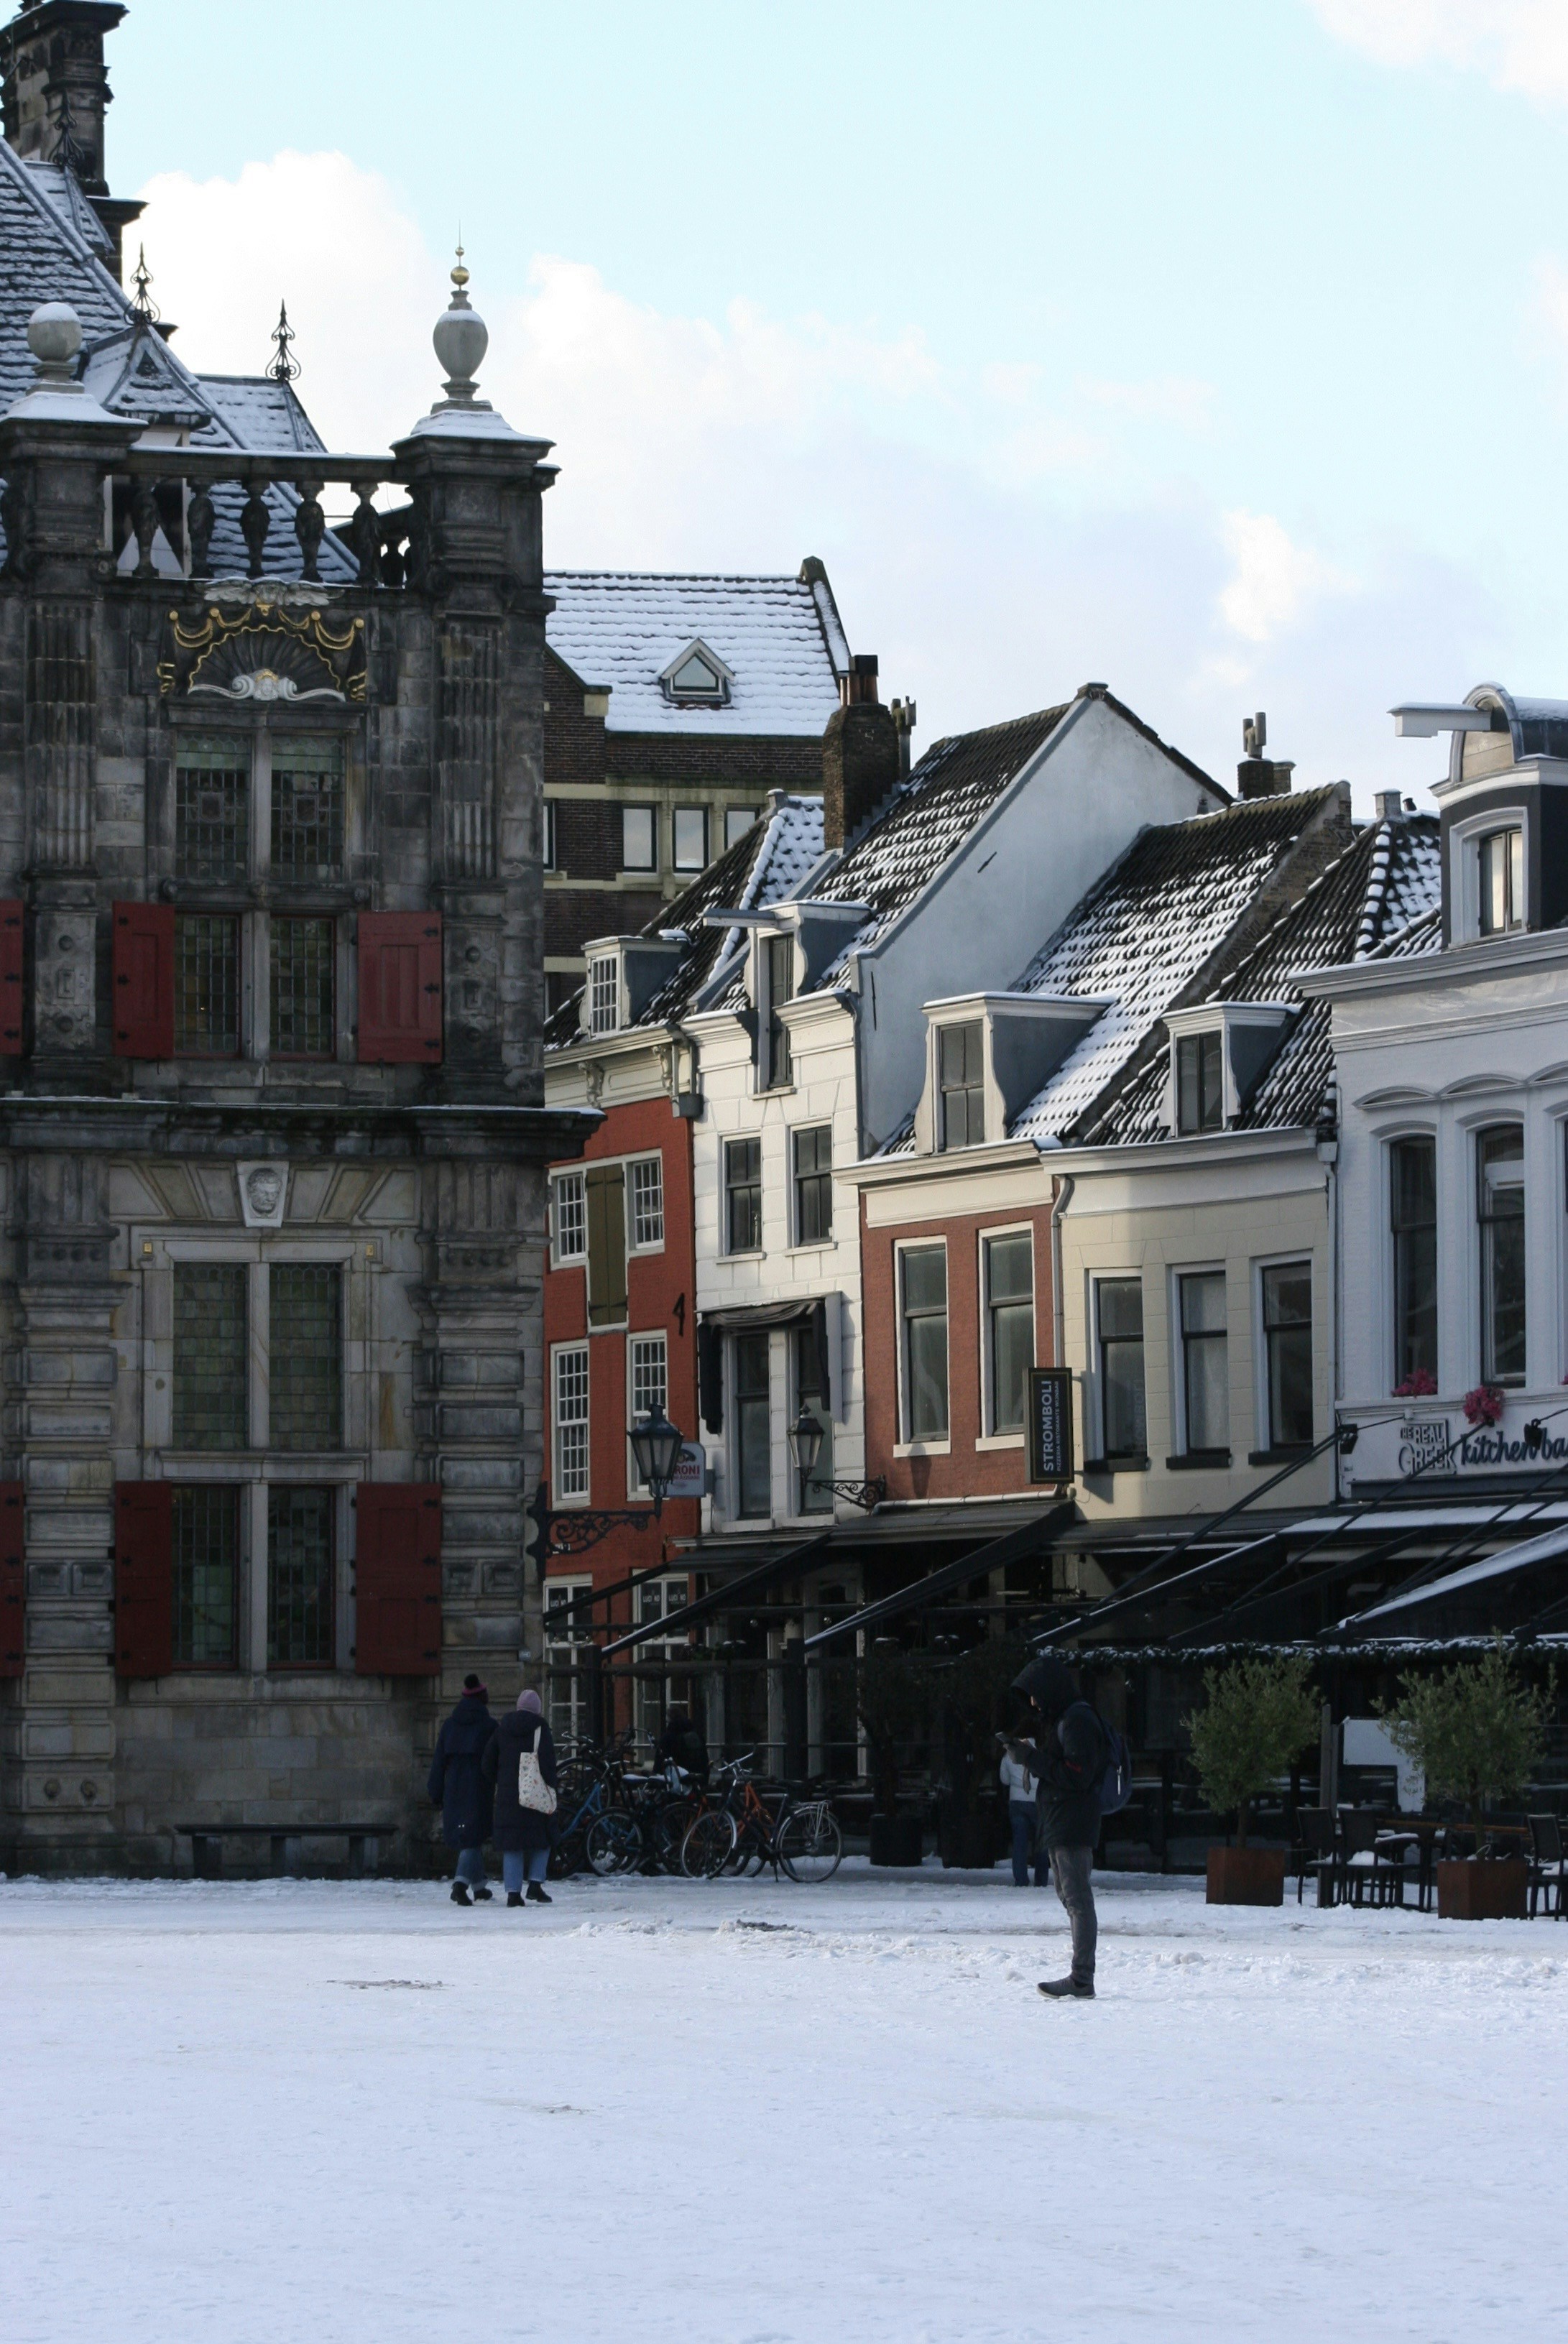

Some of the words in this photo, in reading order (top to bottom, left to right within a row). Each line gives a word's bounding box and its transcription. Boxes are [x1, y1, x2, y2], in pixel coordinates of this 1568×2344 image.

[1041, 1380, 1054, 1472] STROMBOLI
[1413, 1425, 1444, 1444] REAL
[1398, 1442, 1457, 1475] GREEK
[1460, 1430, 1537, 1465] kitchen
[1541, 1427, 1568, 1461] ba
[675, 1465, 701, 1475] RONI
